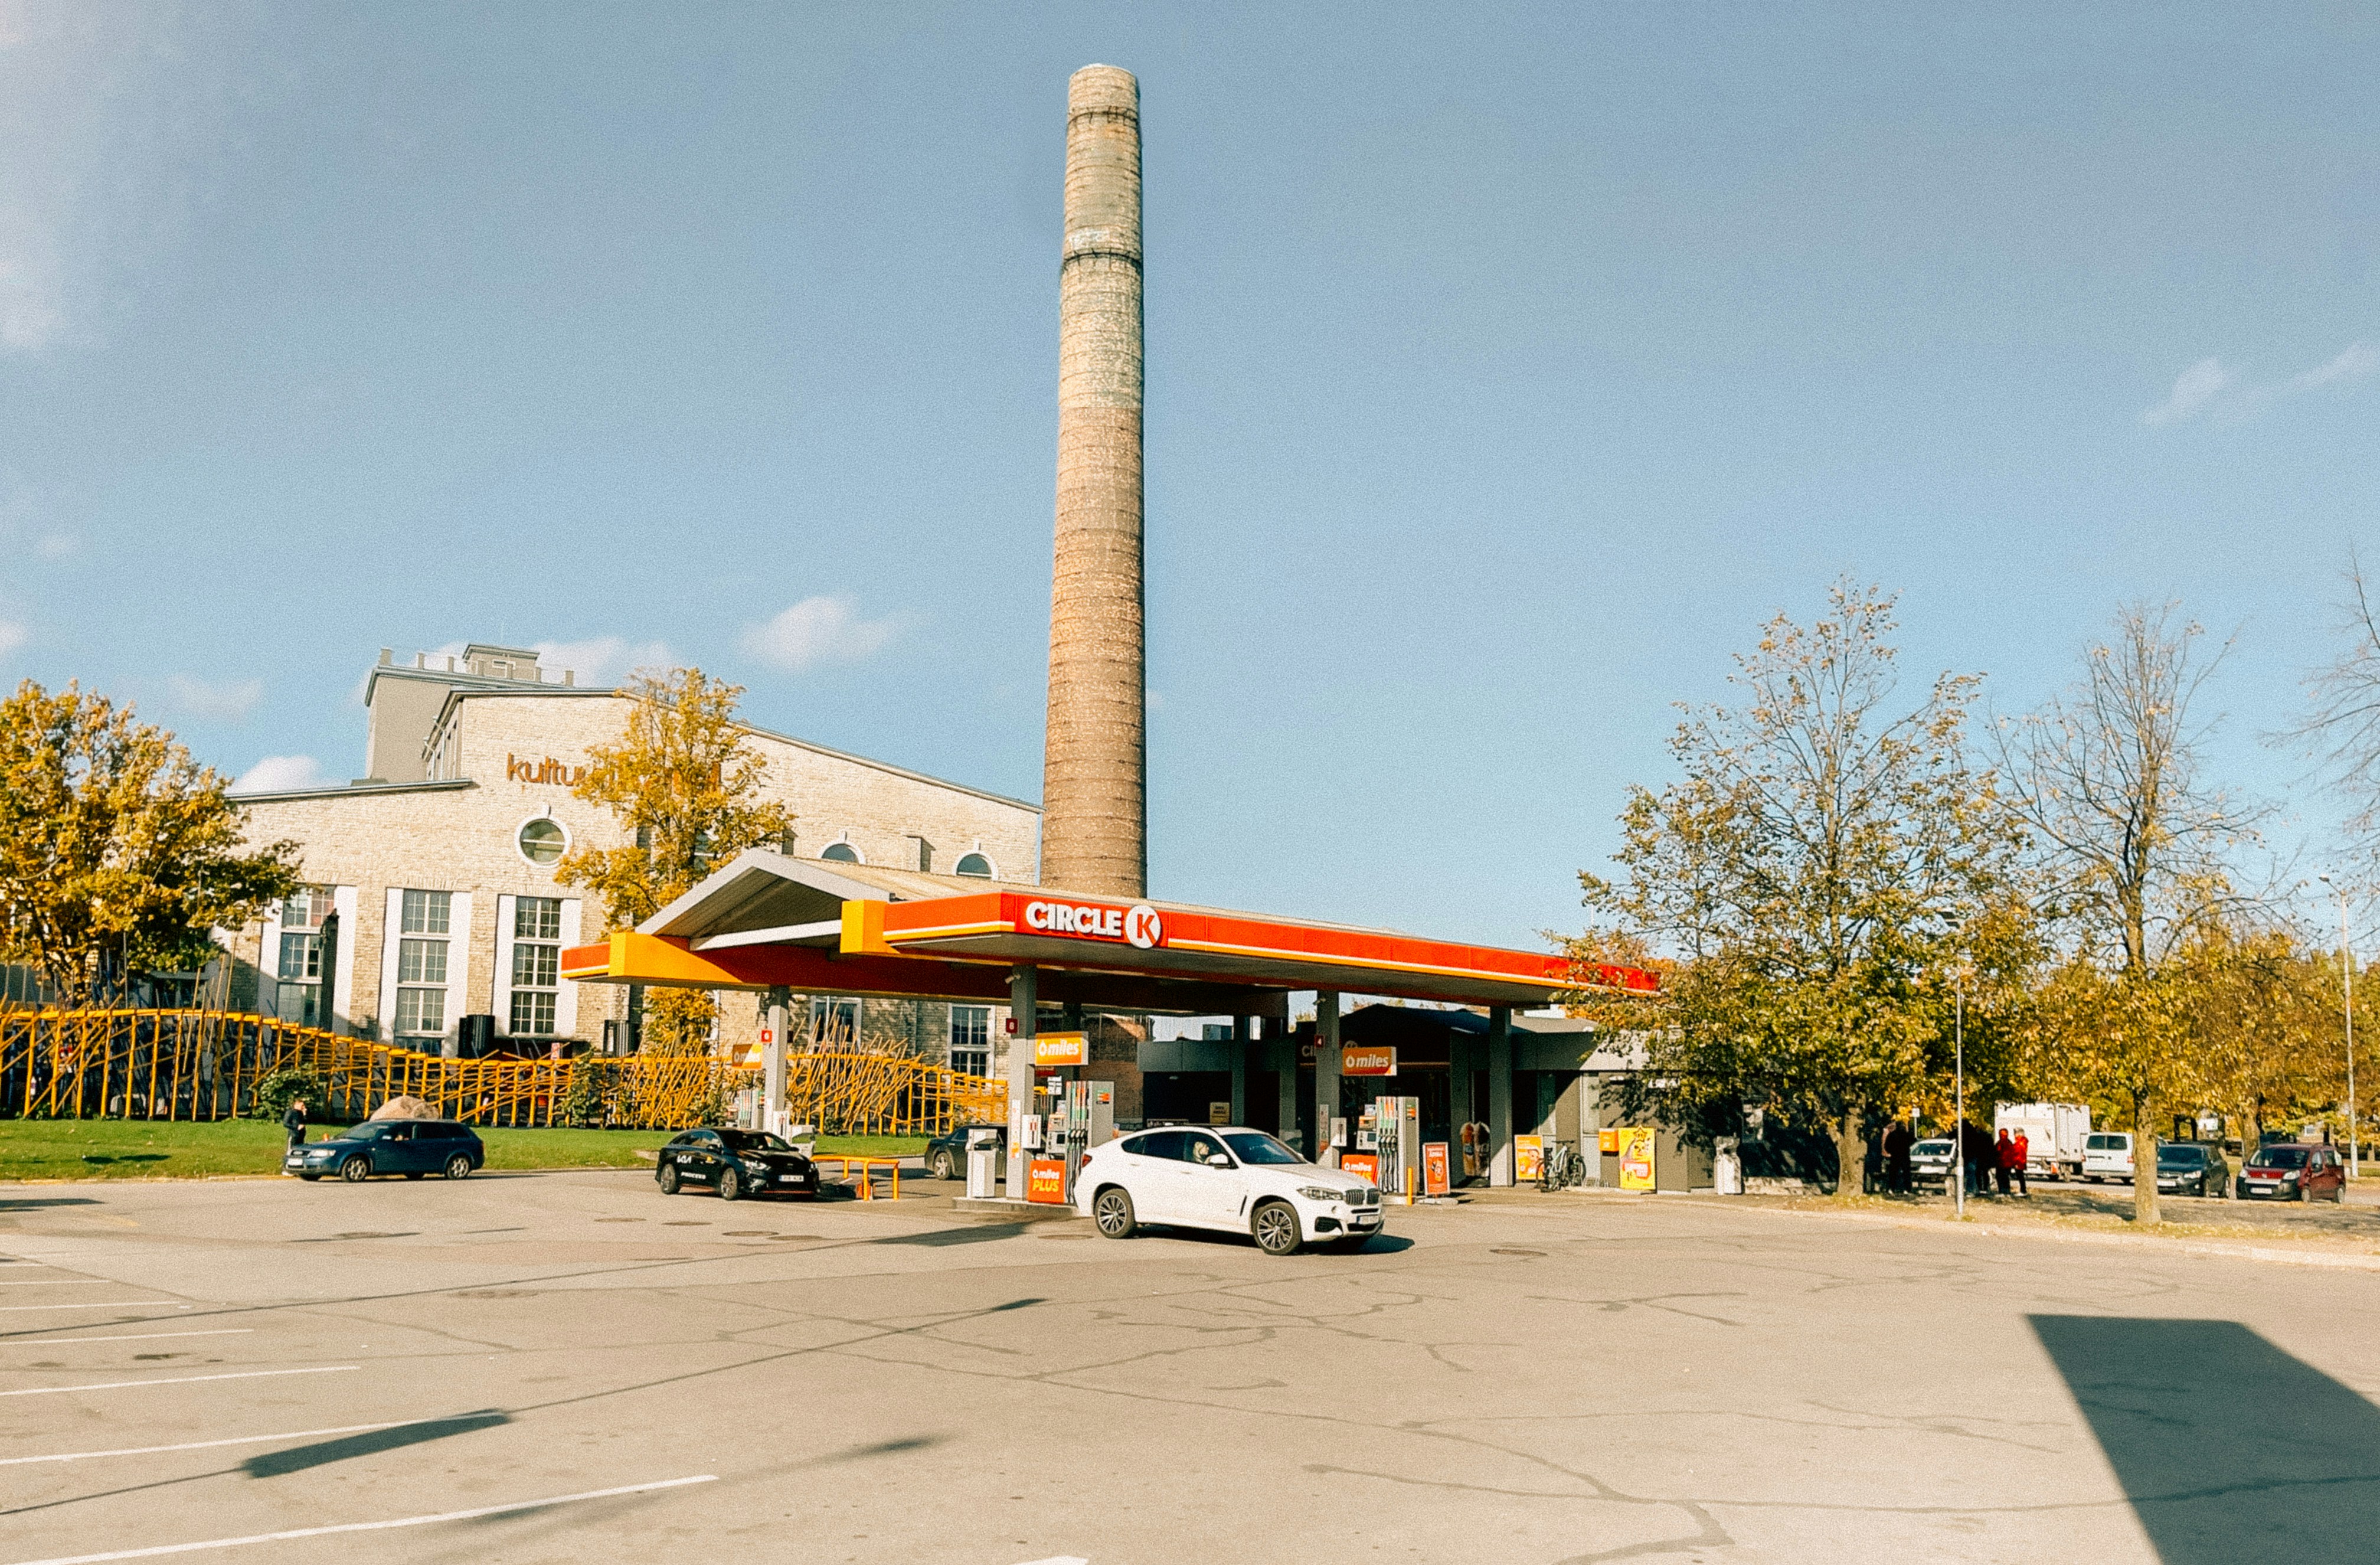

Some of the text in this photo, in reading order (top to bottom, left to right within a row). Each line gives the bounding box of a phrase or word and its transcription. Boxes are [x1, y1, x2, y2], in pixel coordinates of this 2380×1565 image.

[1025, 901, 1122, 937] CIRCLE
[1047, 1039, 1079, 1056] miles
[1356, 1054, 1389, 1068] miles
[1351, 1162, 1372, 1171] miles
[1039, 1169, 1060, 1180] miles
[1032, 1180, 1060, 1192] PLUS
